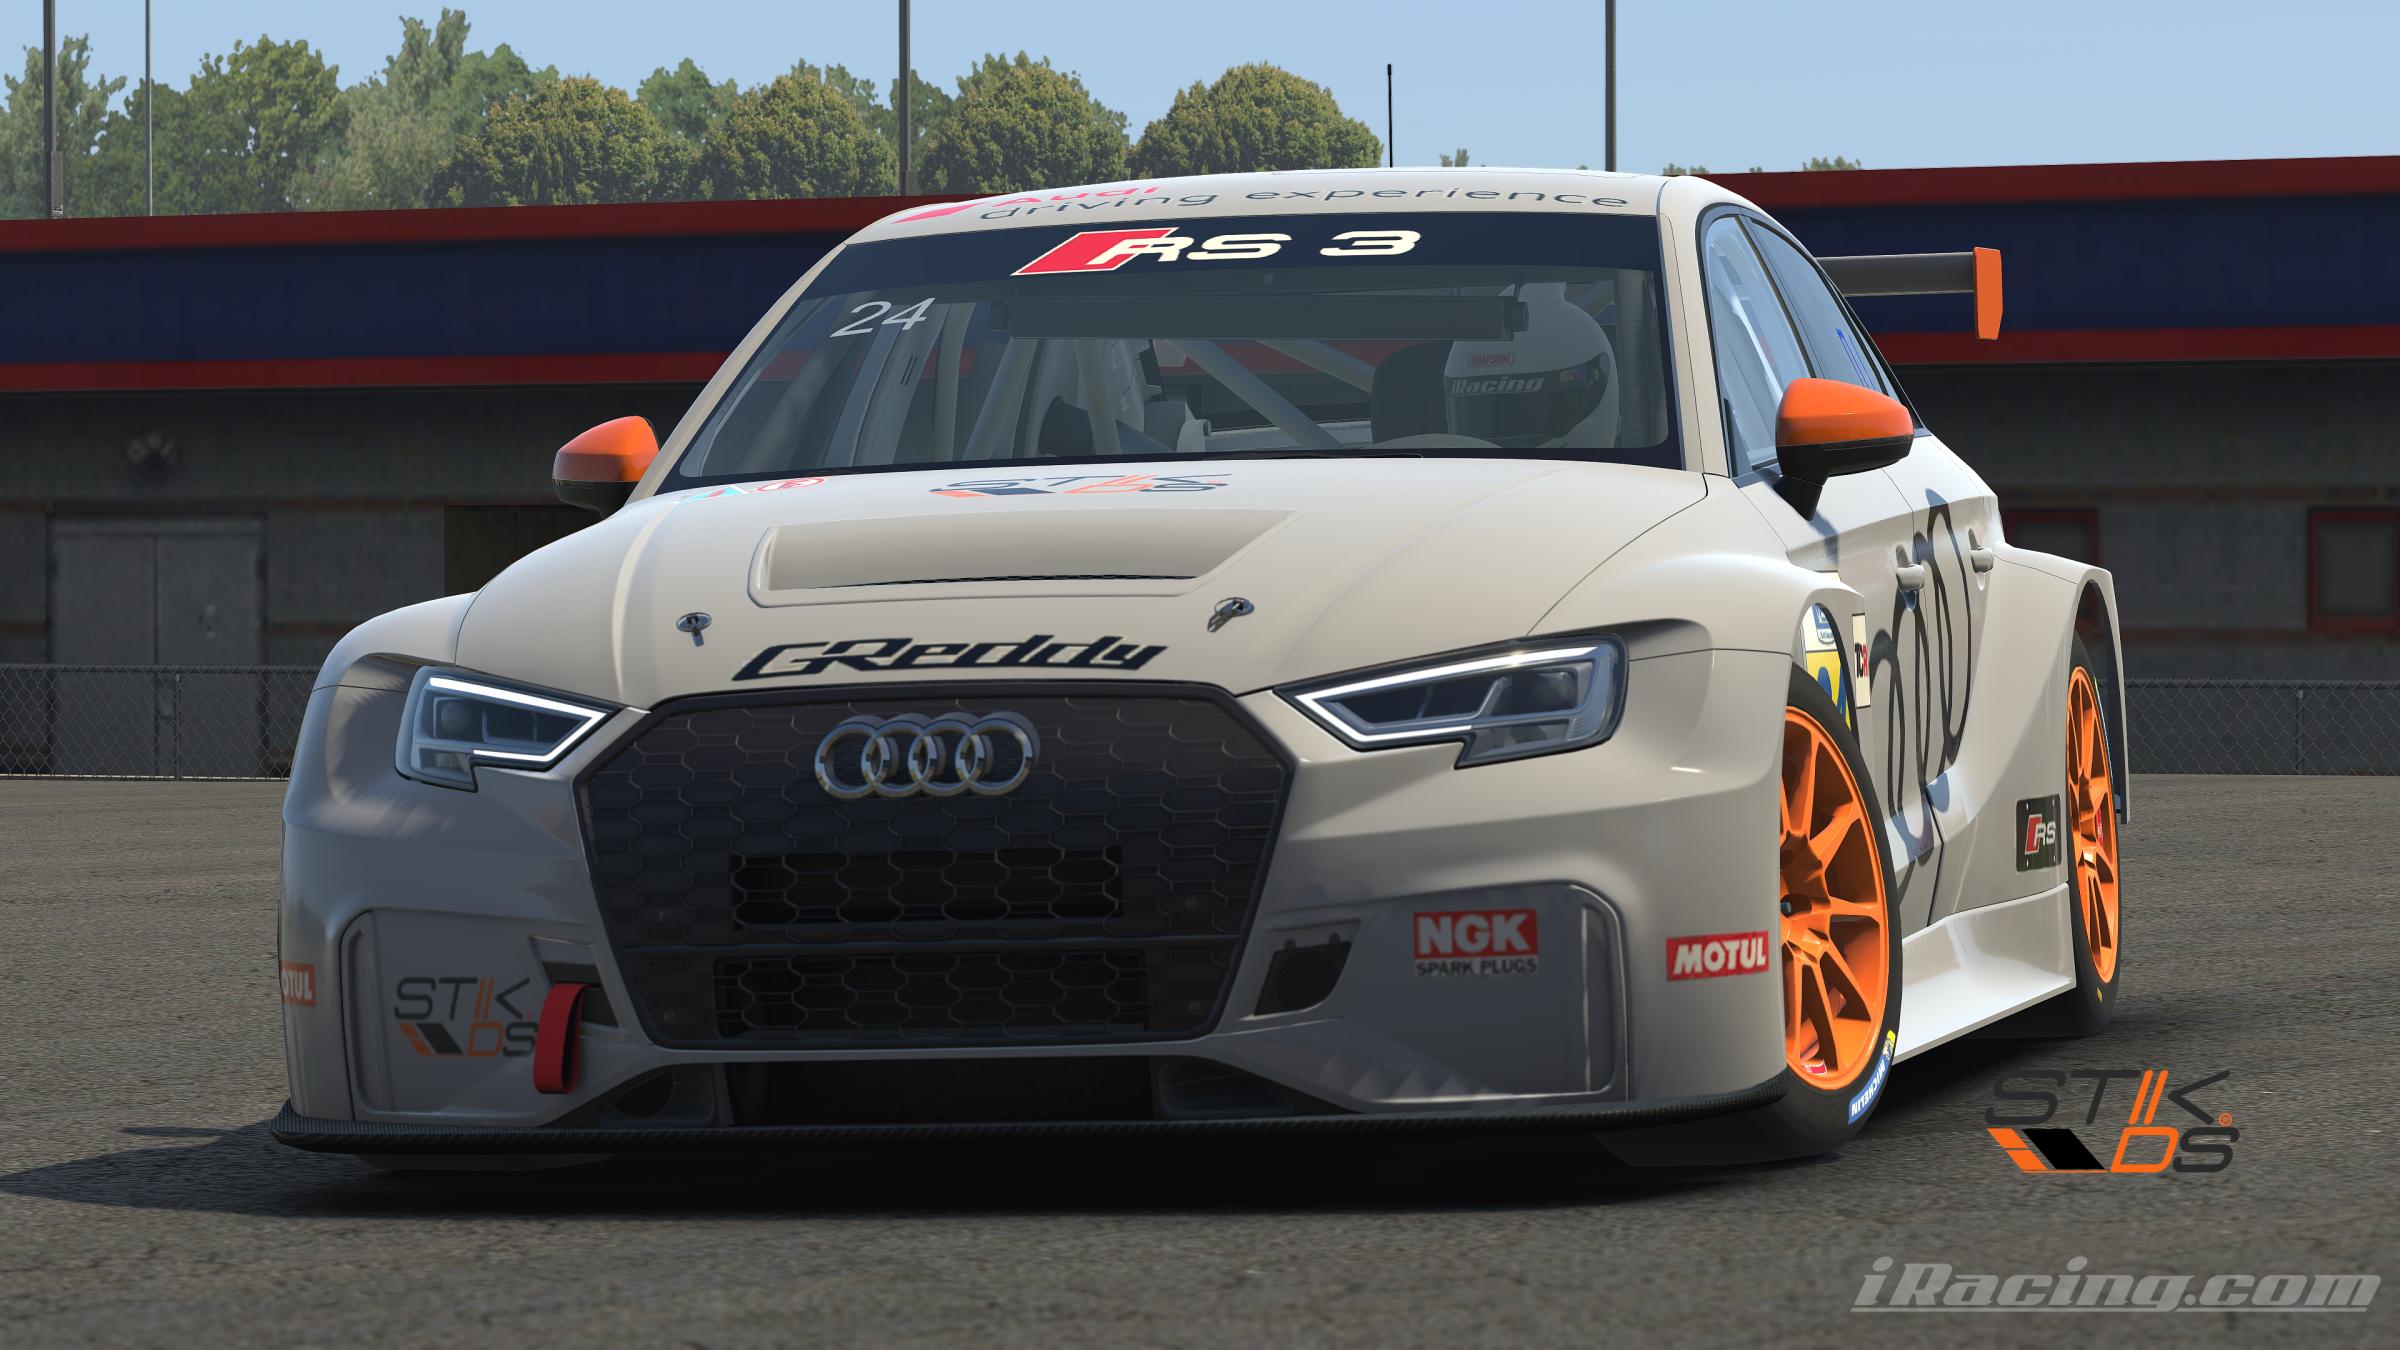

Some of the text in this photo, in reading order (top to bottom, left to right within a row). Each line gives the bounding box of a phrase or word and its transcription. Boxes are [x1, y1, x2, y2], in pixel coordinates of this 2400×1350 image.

[979, 187, 1629, 221] driving experience
[990, 186, 1163, 208] Audi
[1084, 230, 1422, 266] RS 3
[829, 297, 936, 338] 24
[731, 633, 1170, 682] GReddy
[2033, 821, 2057, 847] RS
[1417, 912, 1531, 956] NGK
[1416, 956, 1538, 978] SPARK PLUGS
[1671, 936, 1768, 976] MOTUL
[280, 969, 313, 1001] OTUL
[1851, 1059, 1887, 1118] MICHELIN
